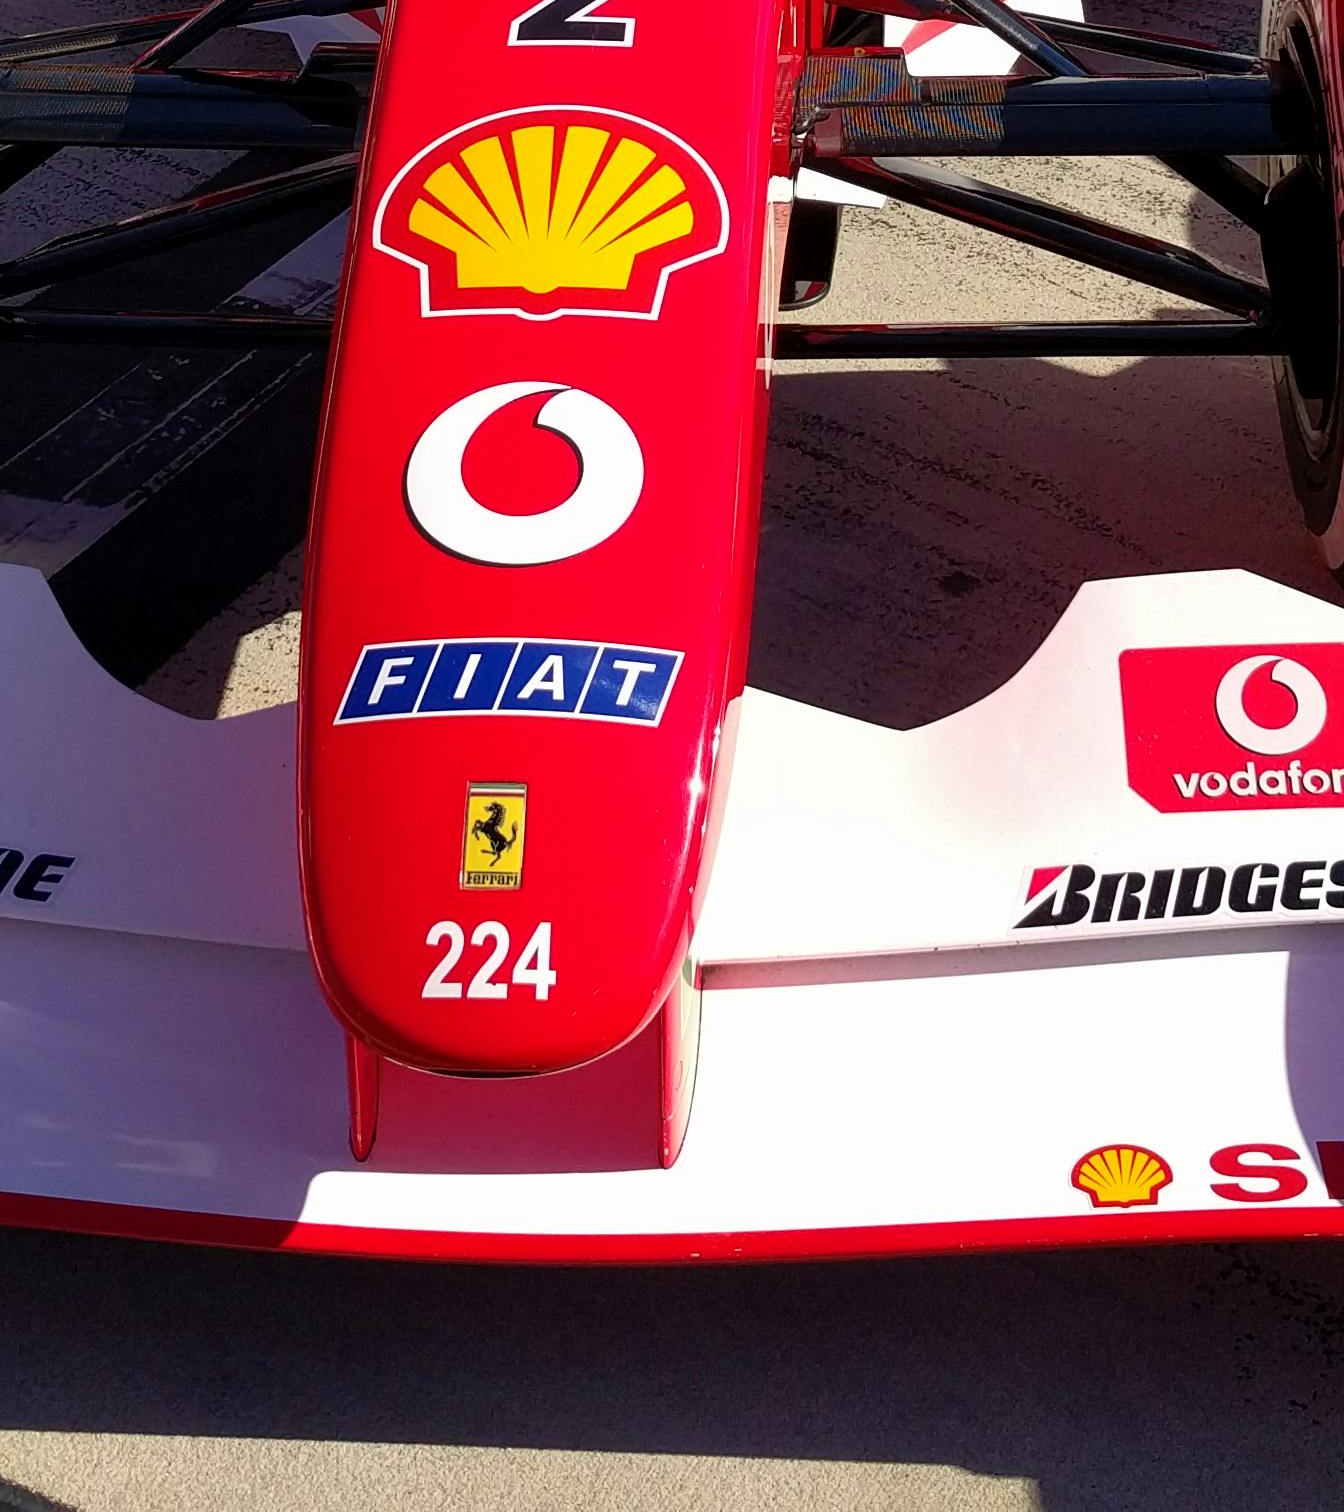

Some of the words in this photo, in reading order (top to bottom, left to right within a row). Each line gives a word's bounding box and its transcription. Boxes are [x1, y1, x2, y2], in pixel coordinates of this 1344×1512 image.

[362, 652, 663, 709] FIAT
[466, 872, 518, 886] Ferrari
[421, 920, 557, 1001] 224
